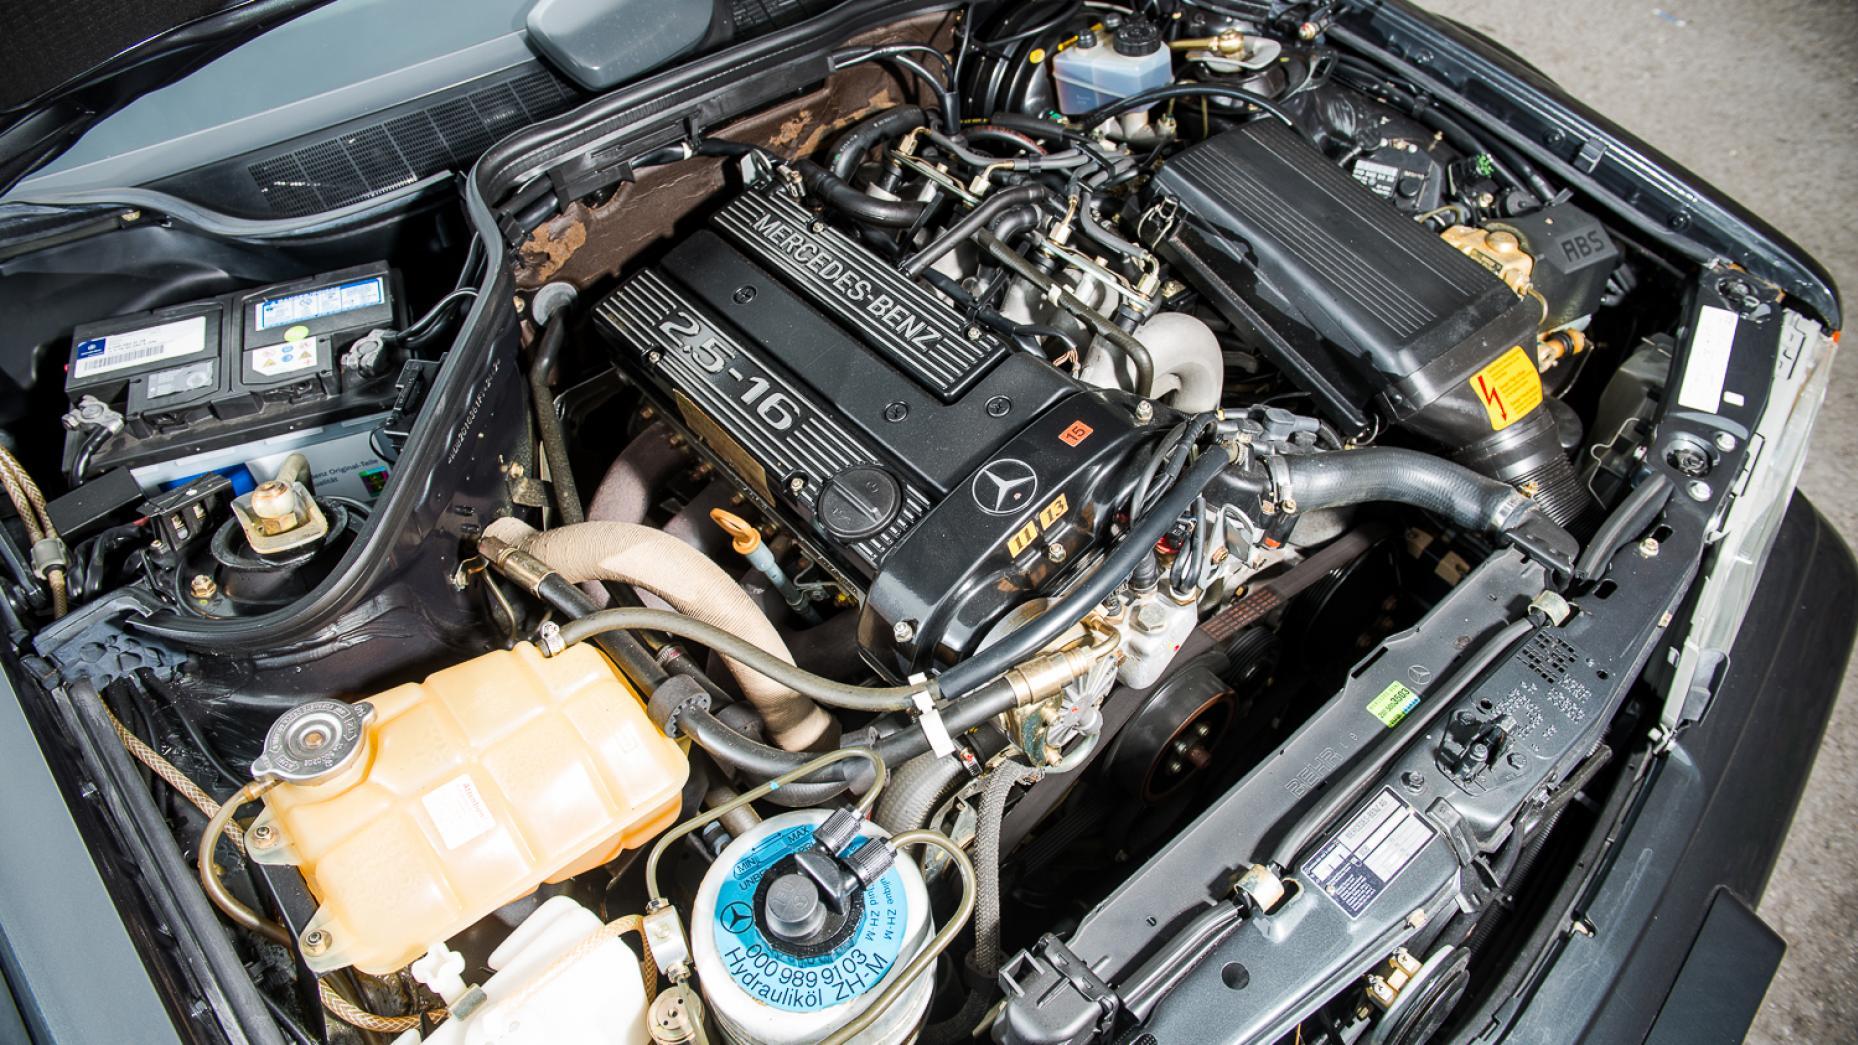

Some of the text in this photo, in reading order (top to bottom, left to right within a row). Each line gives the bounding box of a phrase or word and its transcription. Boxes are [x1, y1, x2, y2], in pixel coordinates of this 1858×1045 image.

[1561, 230, 1605, 262] ABS
[753, 213, 942, 352] MERCEDES-BENZ
[659, 311, 800, 430] 2.5-16
[1065, 426, 1085, 441] 15
[1044, 499, 1064, 523] 13
[1013, 528, 1033, 550] 11
[1284, 747, 1344, 799] BEHR
[787, 826, 810, 844] MAX
[736, 856, 756, 873] MIN
[864, 910, 881, 942] ZH-M
[883, 909, 897, 941] ZH-M
[724, 946, 888, 1008] Hydrauliköl ZH-M
[746, 943, 779, 977] 000
[778, 967, 818, 989] 989
